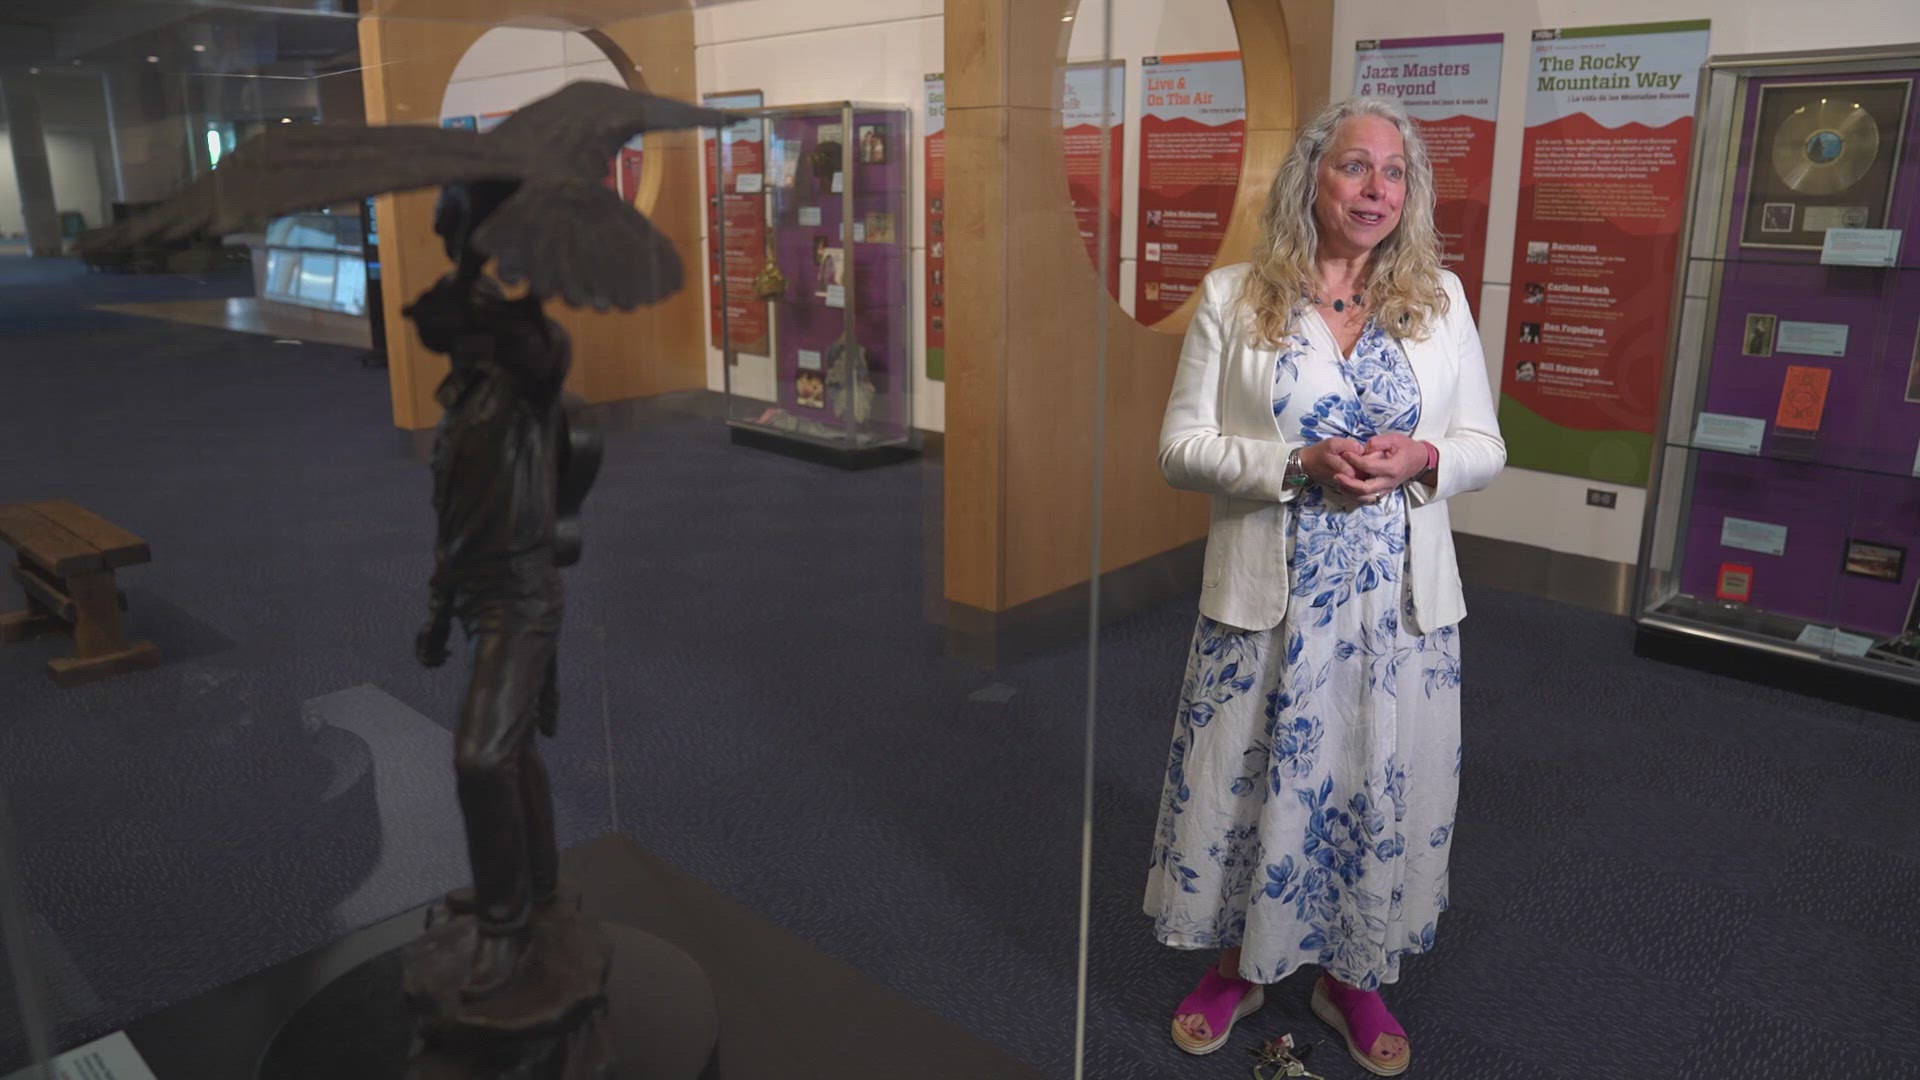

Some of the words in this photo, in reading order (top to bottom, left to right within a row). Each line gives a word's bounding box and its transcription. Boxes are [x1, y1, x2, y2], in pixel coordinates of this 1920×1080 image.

[1539, 57, 1574, 72] The
[1579, 53, 1641, 71] Rocky
[1362, 65, 1399, 79] Jazz
[1402, 63, 1470, 78] Masters
[1147, 78, 1174, 91] Live
[1177, 76, 1187, 90] &
[1361, 83, 1371, 96] &
[1377, 80, 1436, 98] Beyond
[1537, 74, 1630, 91] Mountain
[1637, 72, 1682, 89] Way
[1147, 94, 1164, 107] On
[1166, 92, 1191, 105] The
[1194, 90, 1214, 105] Air
[1552, 242, 1597, 252] Barnstorm
[1547, 283, 1580, 292] Caribou
[1582, 285, 1610, 295] Ranch
[1543, 322, 1560, 331] Dan
[1562, 323, 1604, 336] Fogelberg
[1540, 362, 1554, 370] Bill
